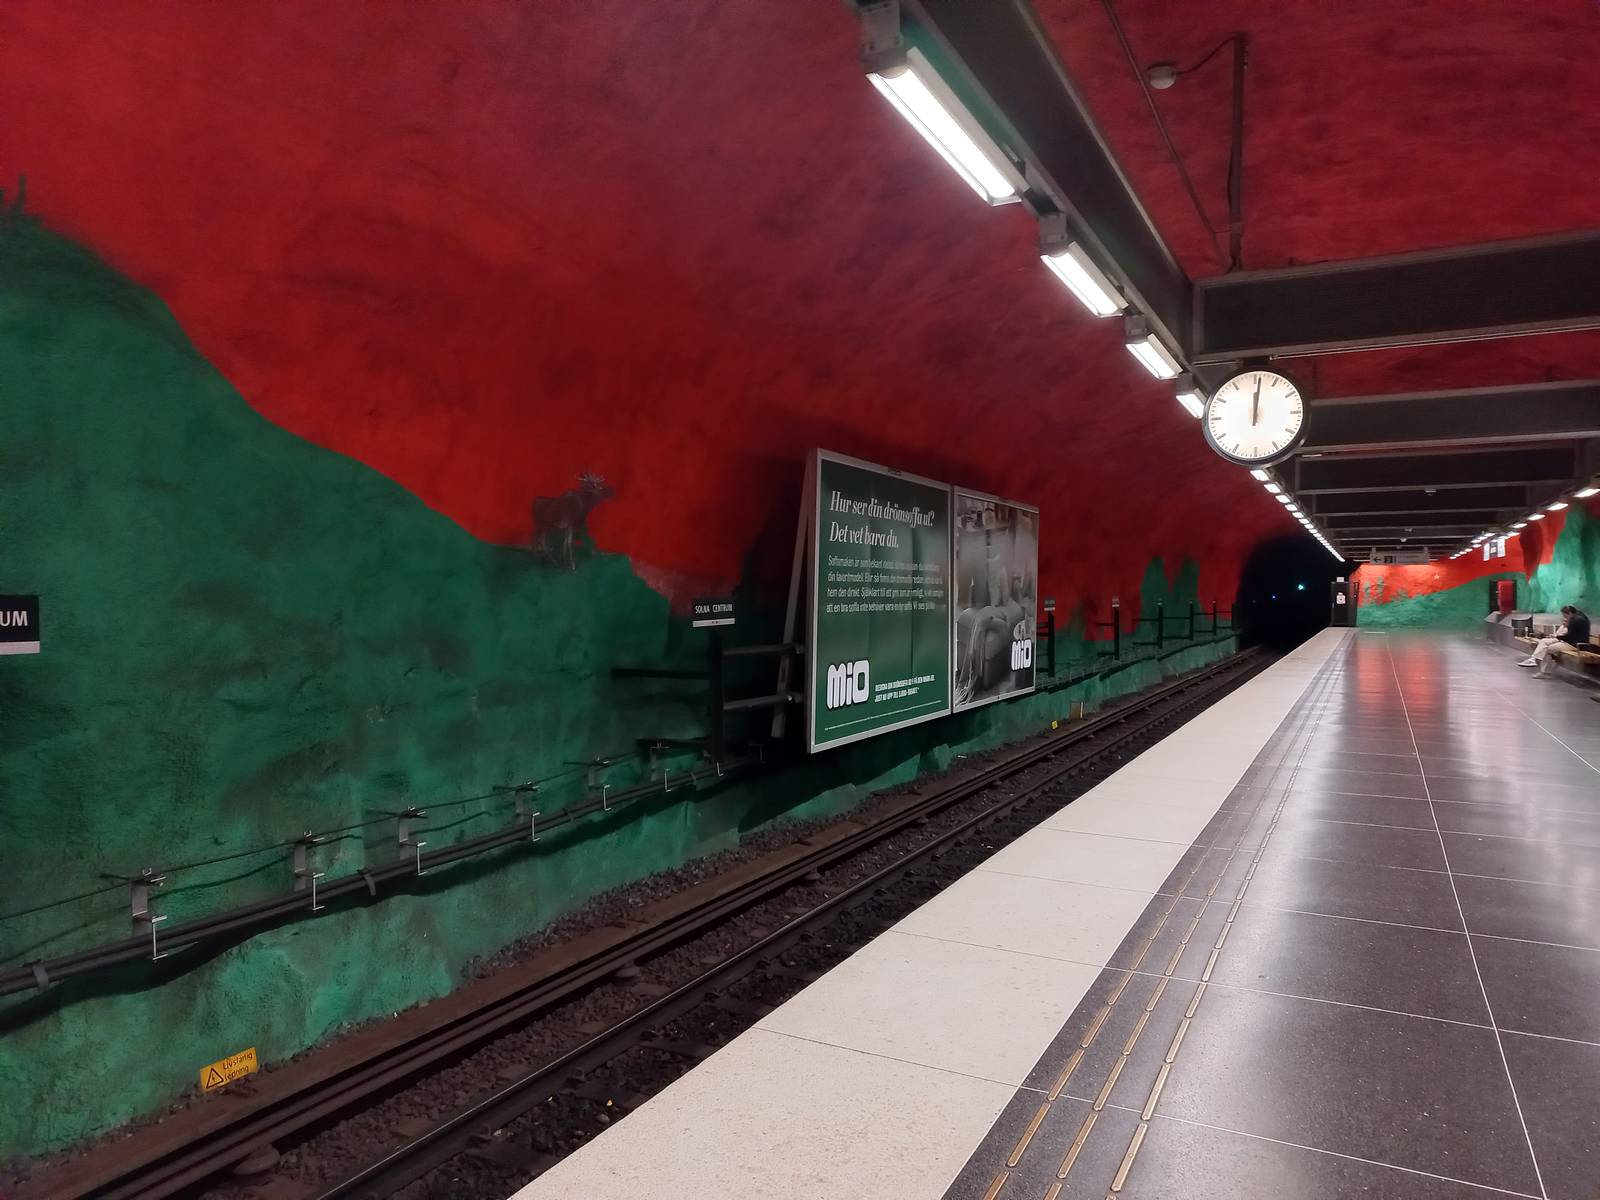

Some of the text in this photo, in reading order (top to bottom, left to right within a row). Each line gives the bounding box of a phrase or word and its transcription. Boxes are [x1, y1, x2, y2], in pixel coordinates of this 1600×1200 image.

[830, 490, 935, 528] Hur ser din drömsoffa ut?
[829, 521, 899, 548] Det vet bara du.
[0, 610, 28, 627] UM
[222, 1052, 253, 1070] Livsfarlig
[224, 1065, 249, 1081] ledning
